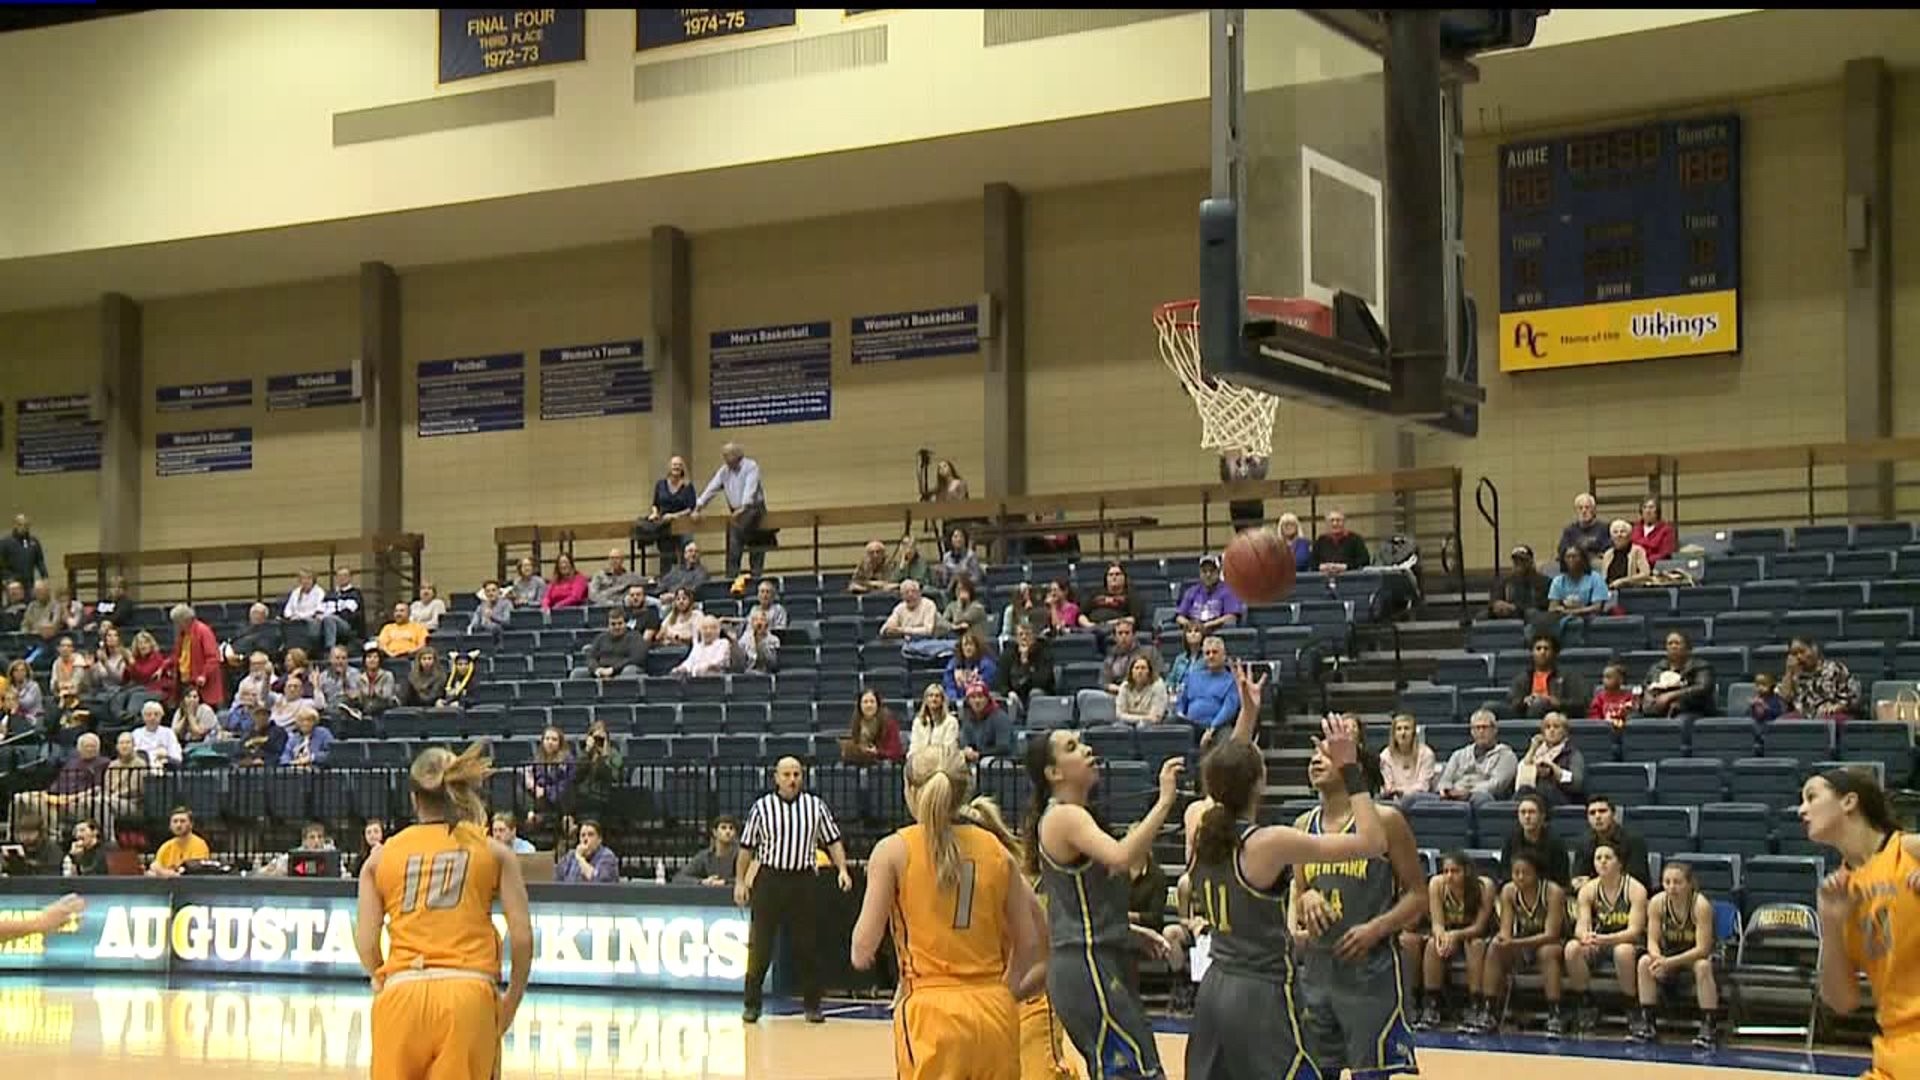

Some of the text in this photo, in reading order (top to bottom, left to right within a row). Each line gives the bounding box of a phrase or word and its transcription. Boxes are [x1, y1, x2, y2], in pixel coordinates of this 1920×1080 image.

[467, 9, 555, 36] FINAL FOUR
[684, 11, 745, 35] 1974-75
[483, 45, 539, 68] 1972-73
[864, 311, 964, 331] Women's Basketball
[1631, 311, 1718, 339] Vikings
[730, 325, 810, 345] Men's Basketball
[402, 850, 470, 914] 10
[953, 859, 976, 930] 1
[1203, 879, 1231, 934] 11
[1757, 908, 1808, 926] AUGUSTANA
